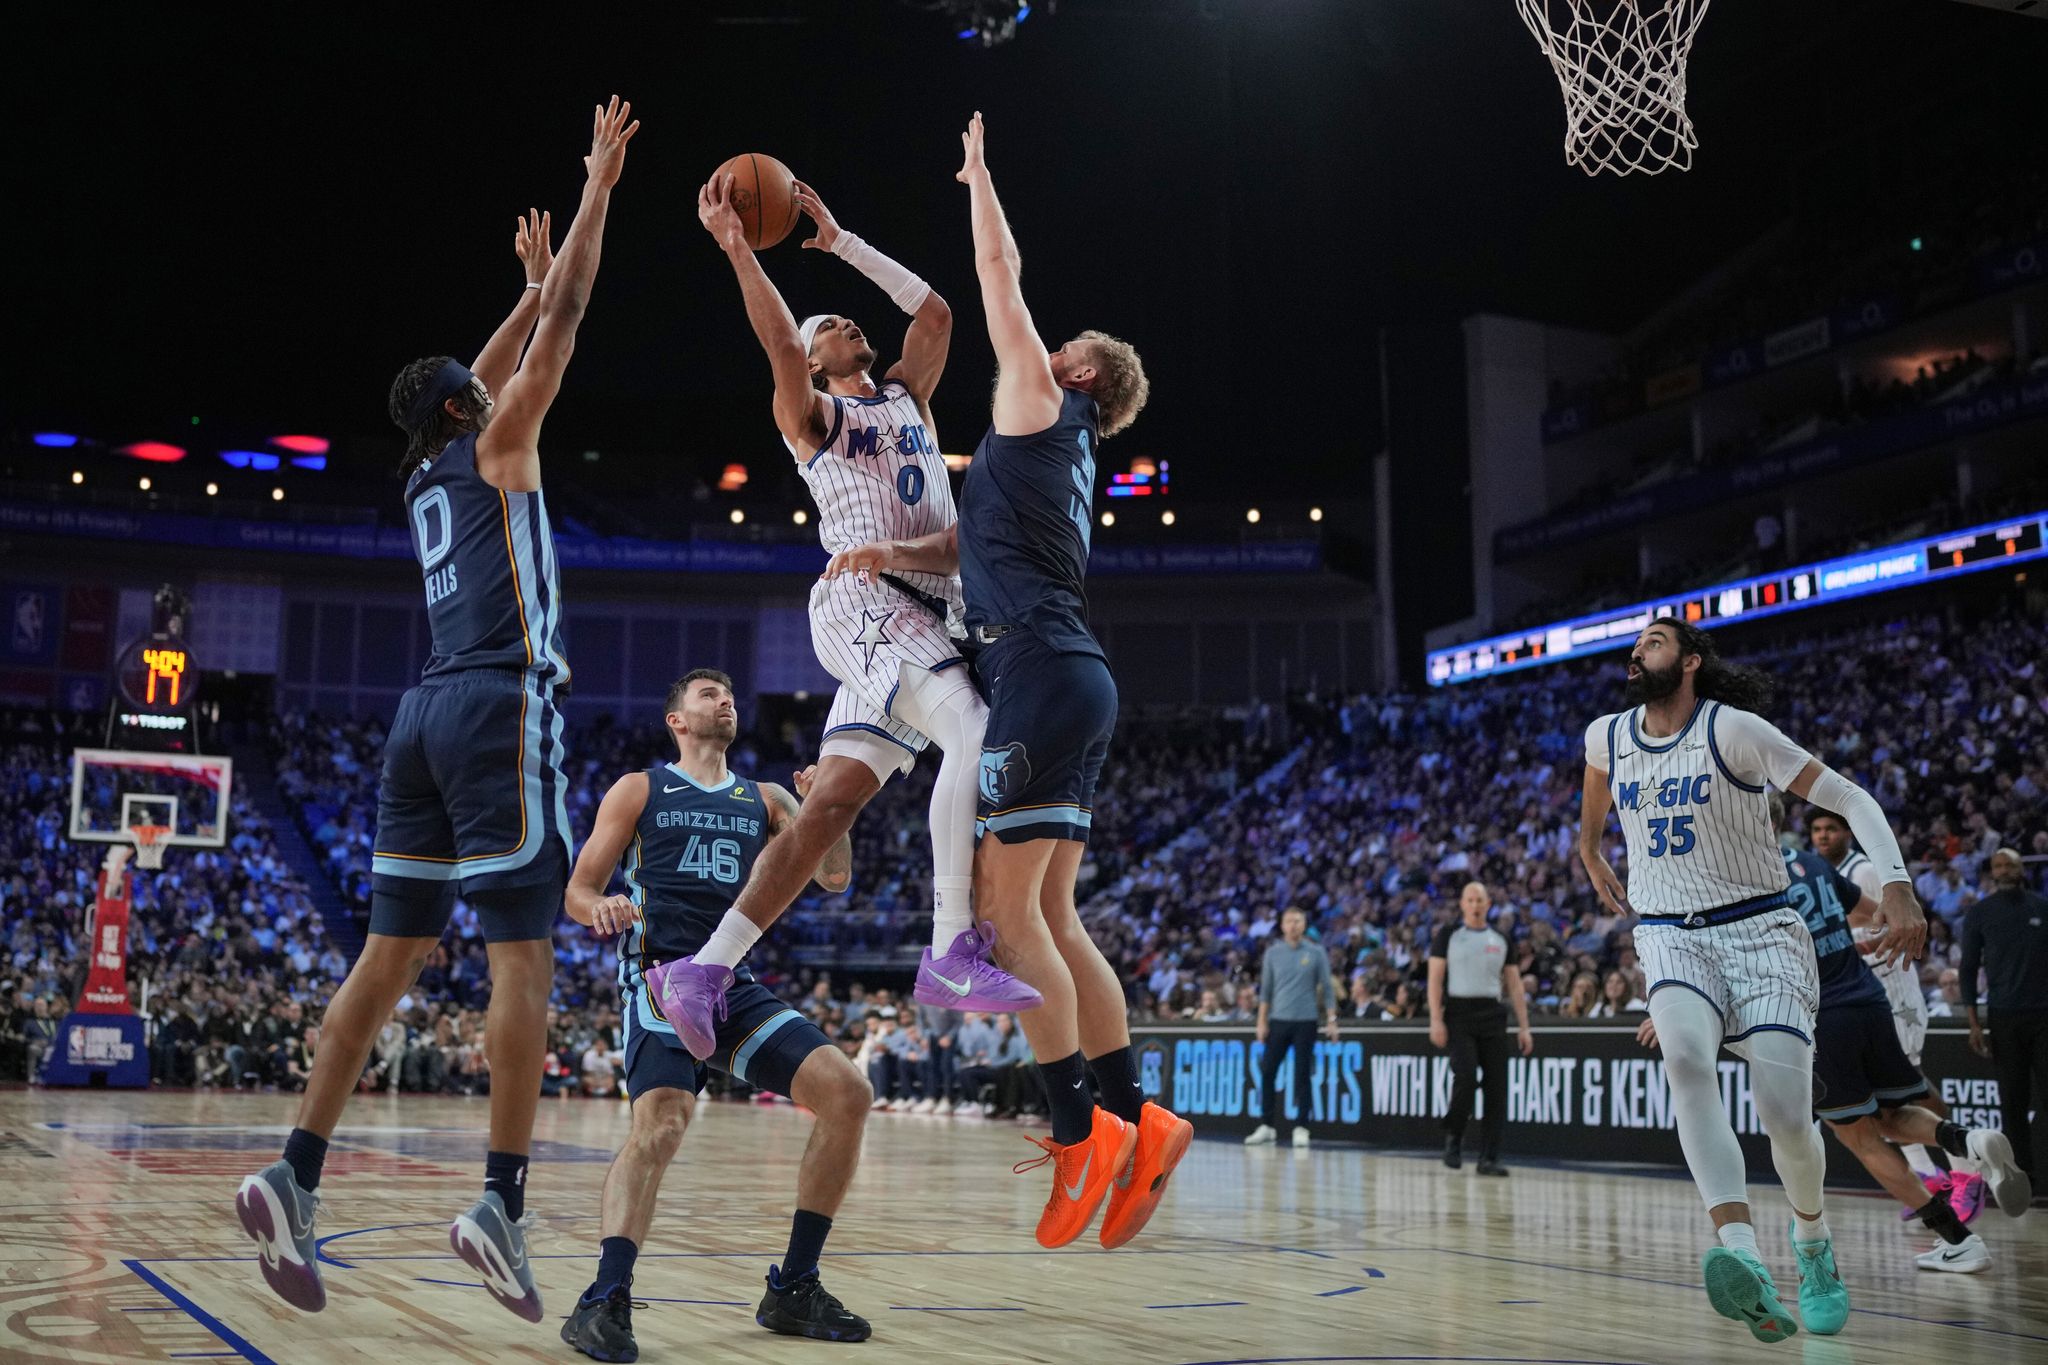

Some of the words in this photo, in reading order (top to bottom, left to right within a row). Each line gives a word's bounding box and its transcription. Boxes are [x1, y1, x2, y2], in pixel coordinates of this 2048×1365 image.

[897, 464, 924, 506] 0
[413, 484, 452, 570] 0
[656, 811, 760, 837] GRIZZLIES
[1648, 815, 1696, 858] 35
[676, 835, 741, 884] 46
[1787, 875, 1845, 932] 24
[1173, 1040, 1245, 1116] GOOD
[1371, 1055, 1427, 1118] WITH
[1507, 1057, 1576, 1125] HART
[1583, 1058, 1604, 1127] &
[1941, 1078, 2001, 1105] EVER
